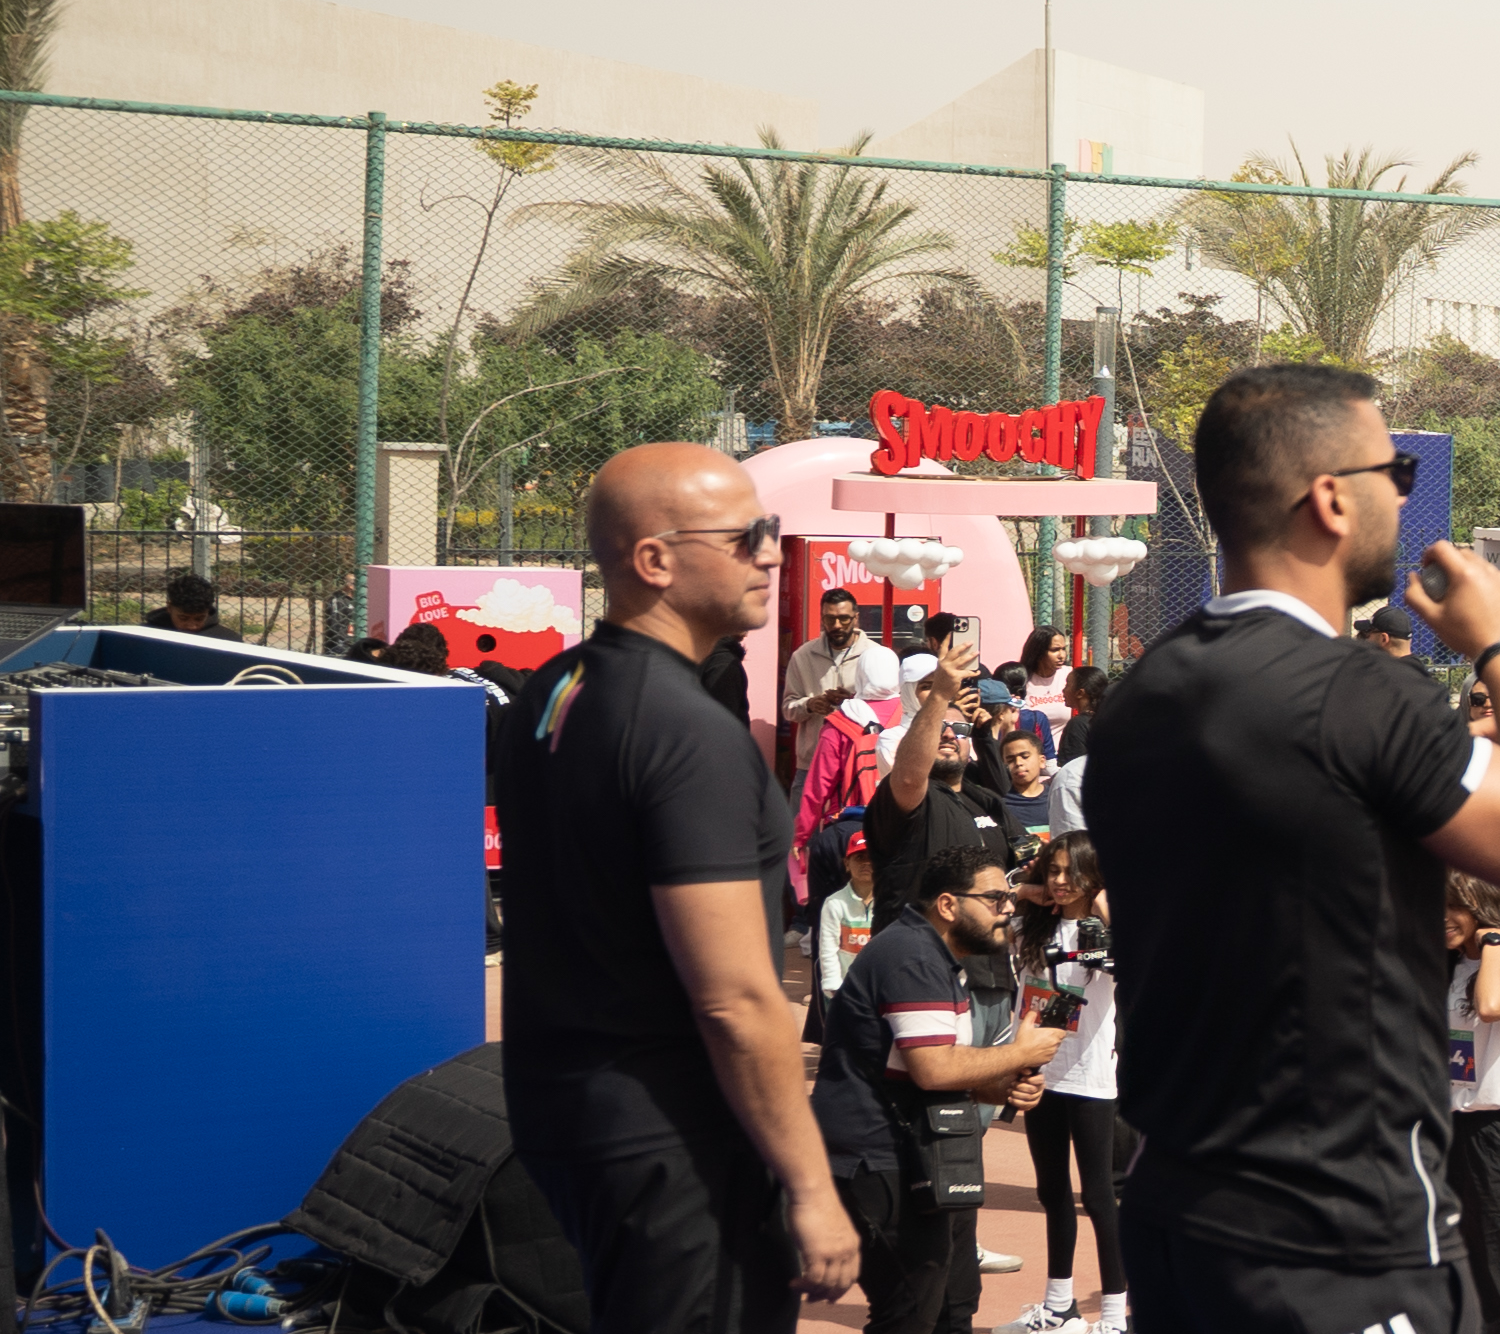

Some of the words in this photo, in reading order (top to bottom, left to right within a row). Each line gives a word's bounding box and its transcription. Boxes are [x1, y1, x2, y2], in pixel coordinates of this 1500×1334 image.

[870, 390, 1103, 480] SMOOCHY
[420, 595, 441, 609] BIG
[419, 608, 449, 623] LOVE
